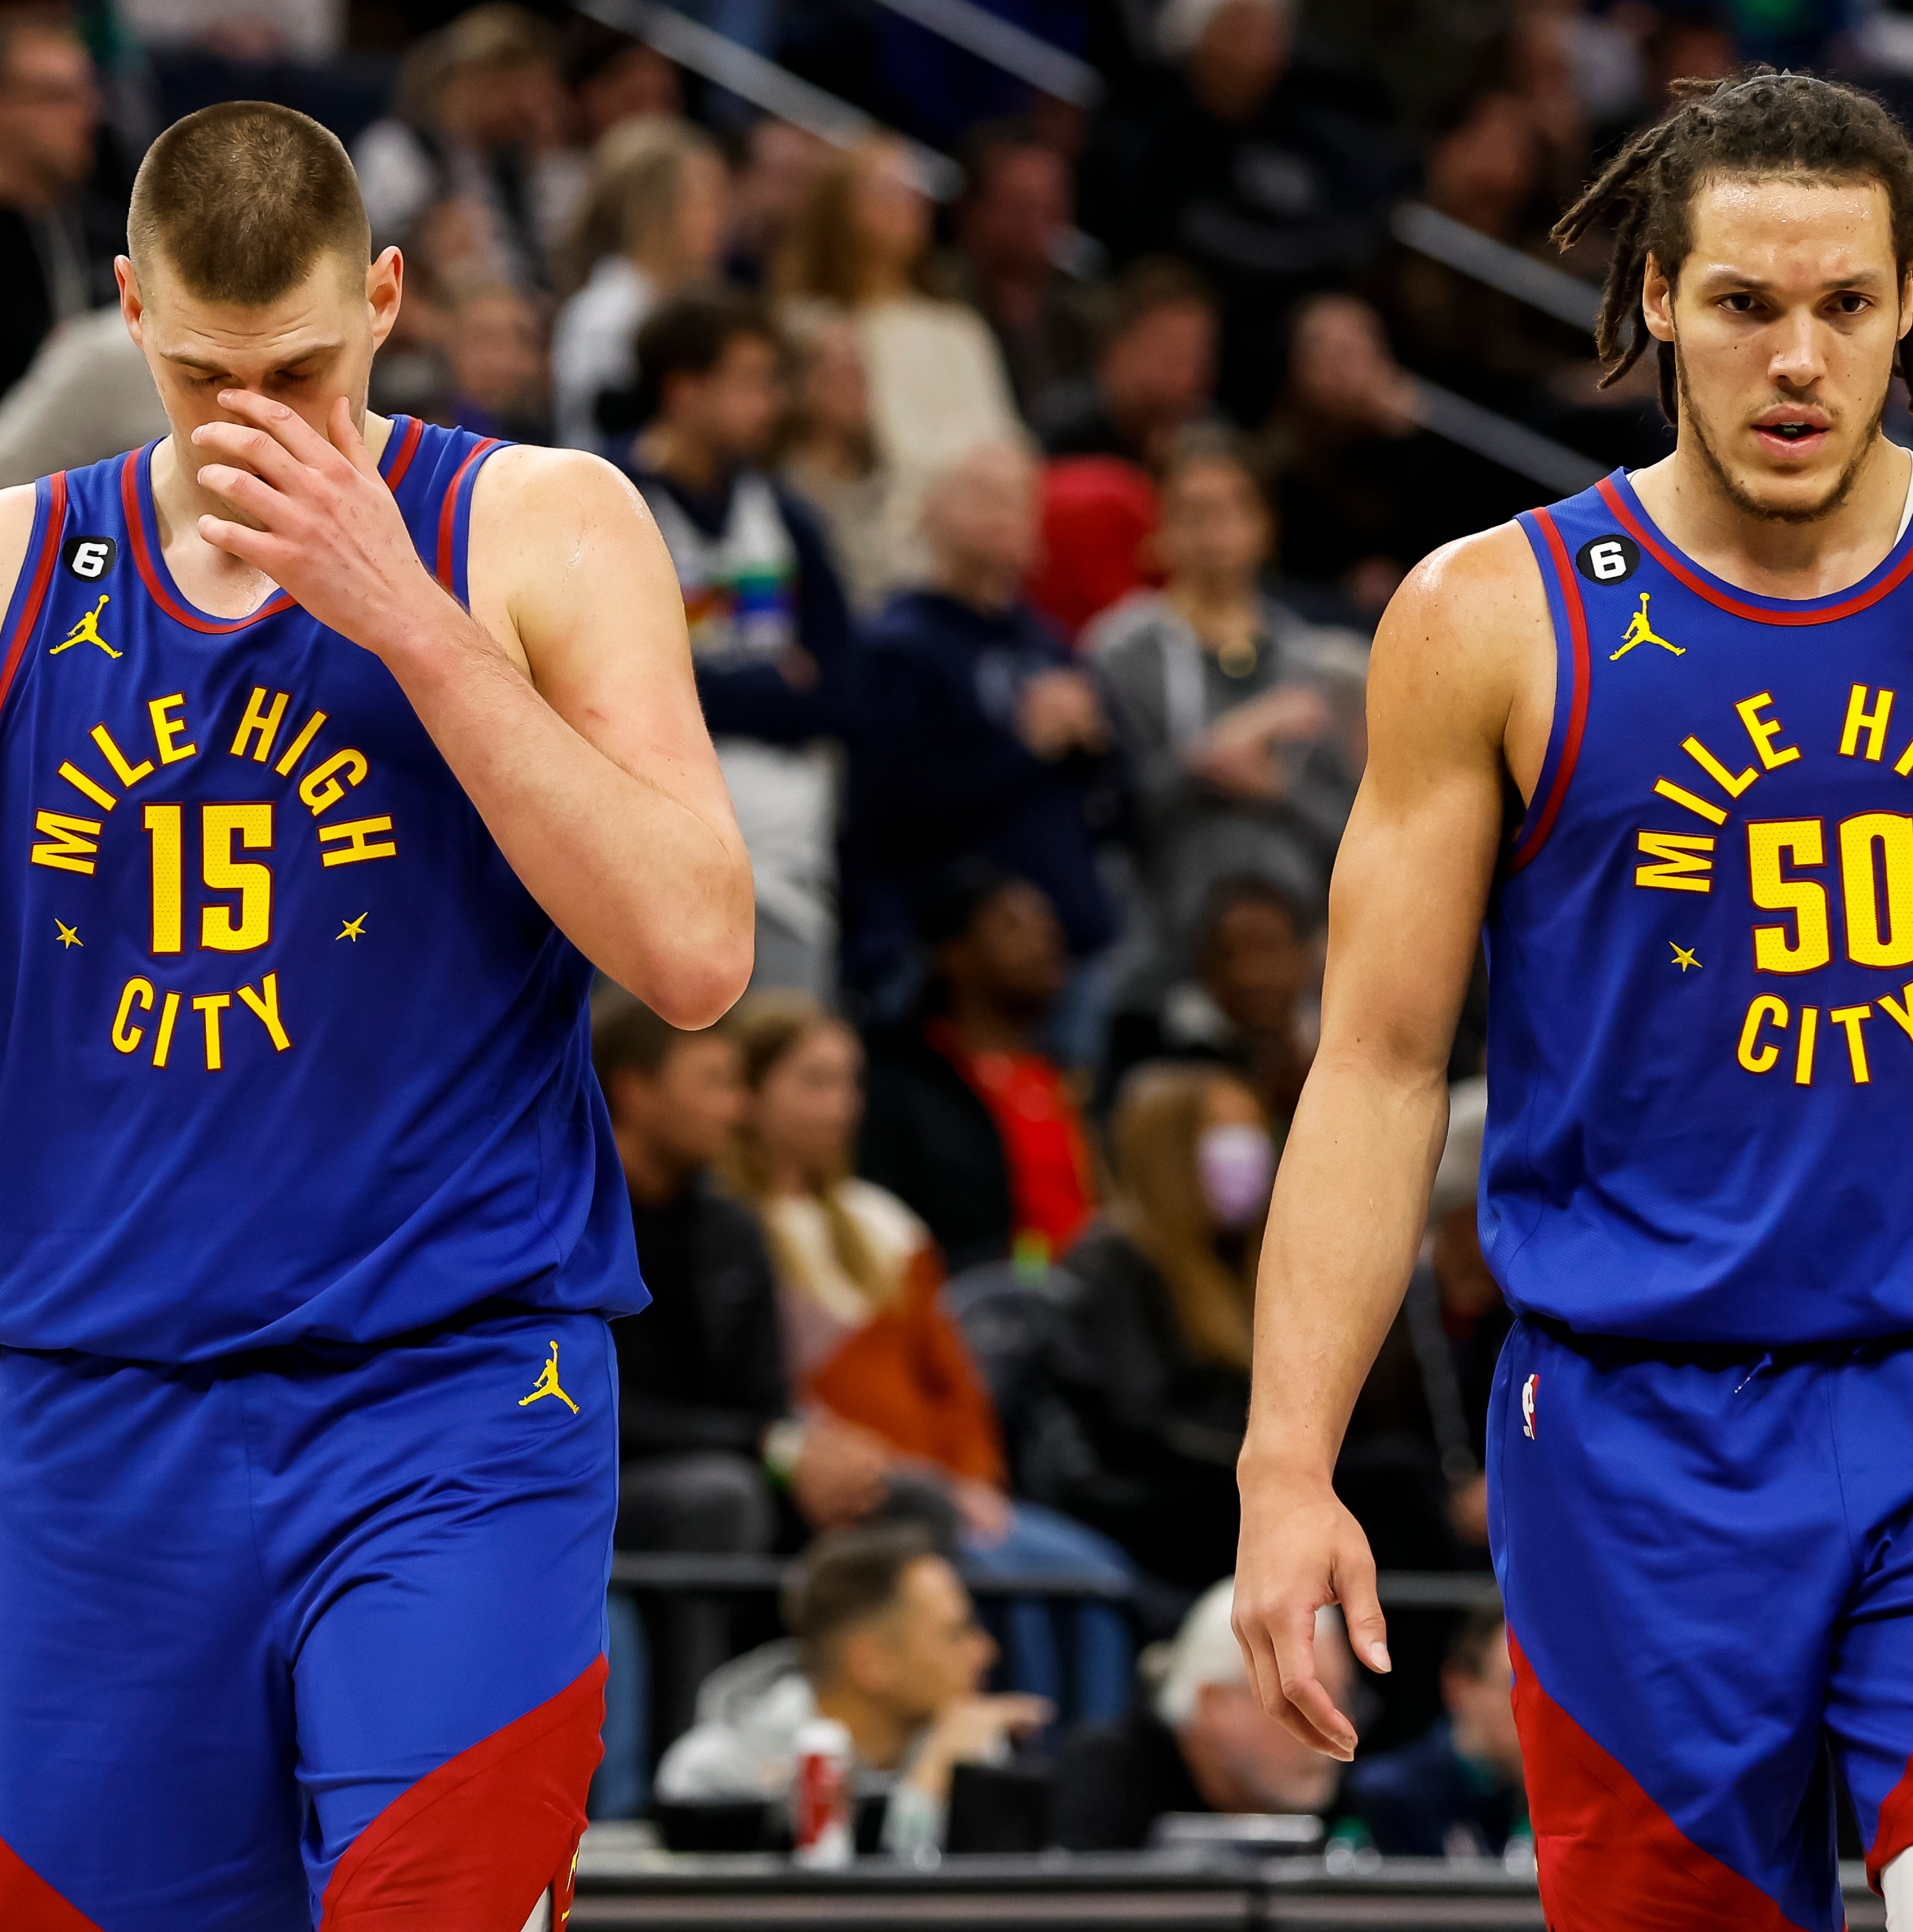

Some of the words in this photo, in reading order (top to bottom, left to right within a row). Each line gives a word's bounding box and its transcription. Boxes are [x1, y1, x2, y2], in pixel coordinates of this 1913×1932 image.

[72, 542, 108, 578] 6
[1590, 541, 1626, 579] 6
[29, 690, 198, 876] MILE
[228, 685, 398, 869] HIGH
[1634, 690, 1802, 894] MILE
[142, 802, 274, 954] 15
[1745, 811, 1913, 974] 50
[110, 971, 292, 1072] CITY
